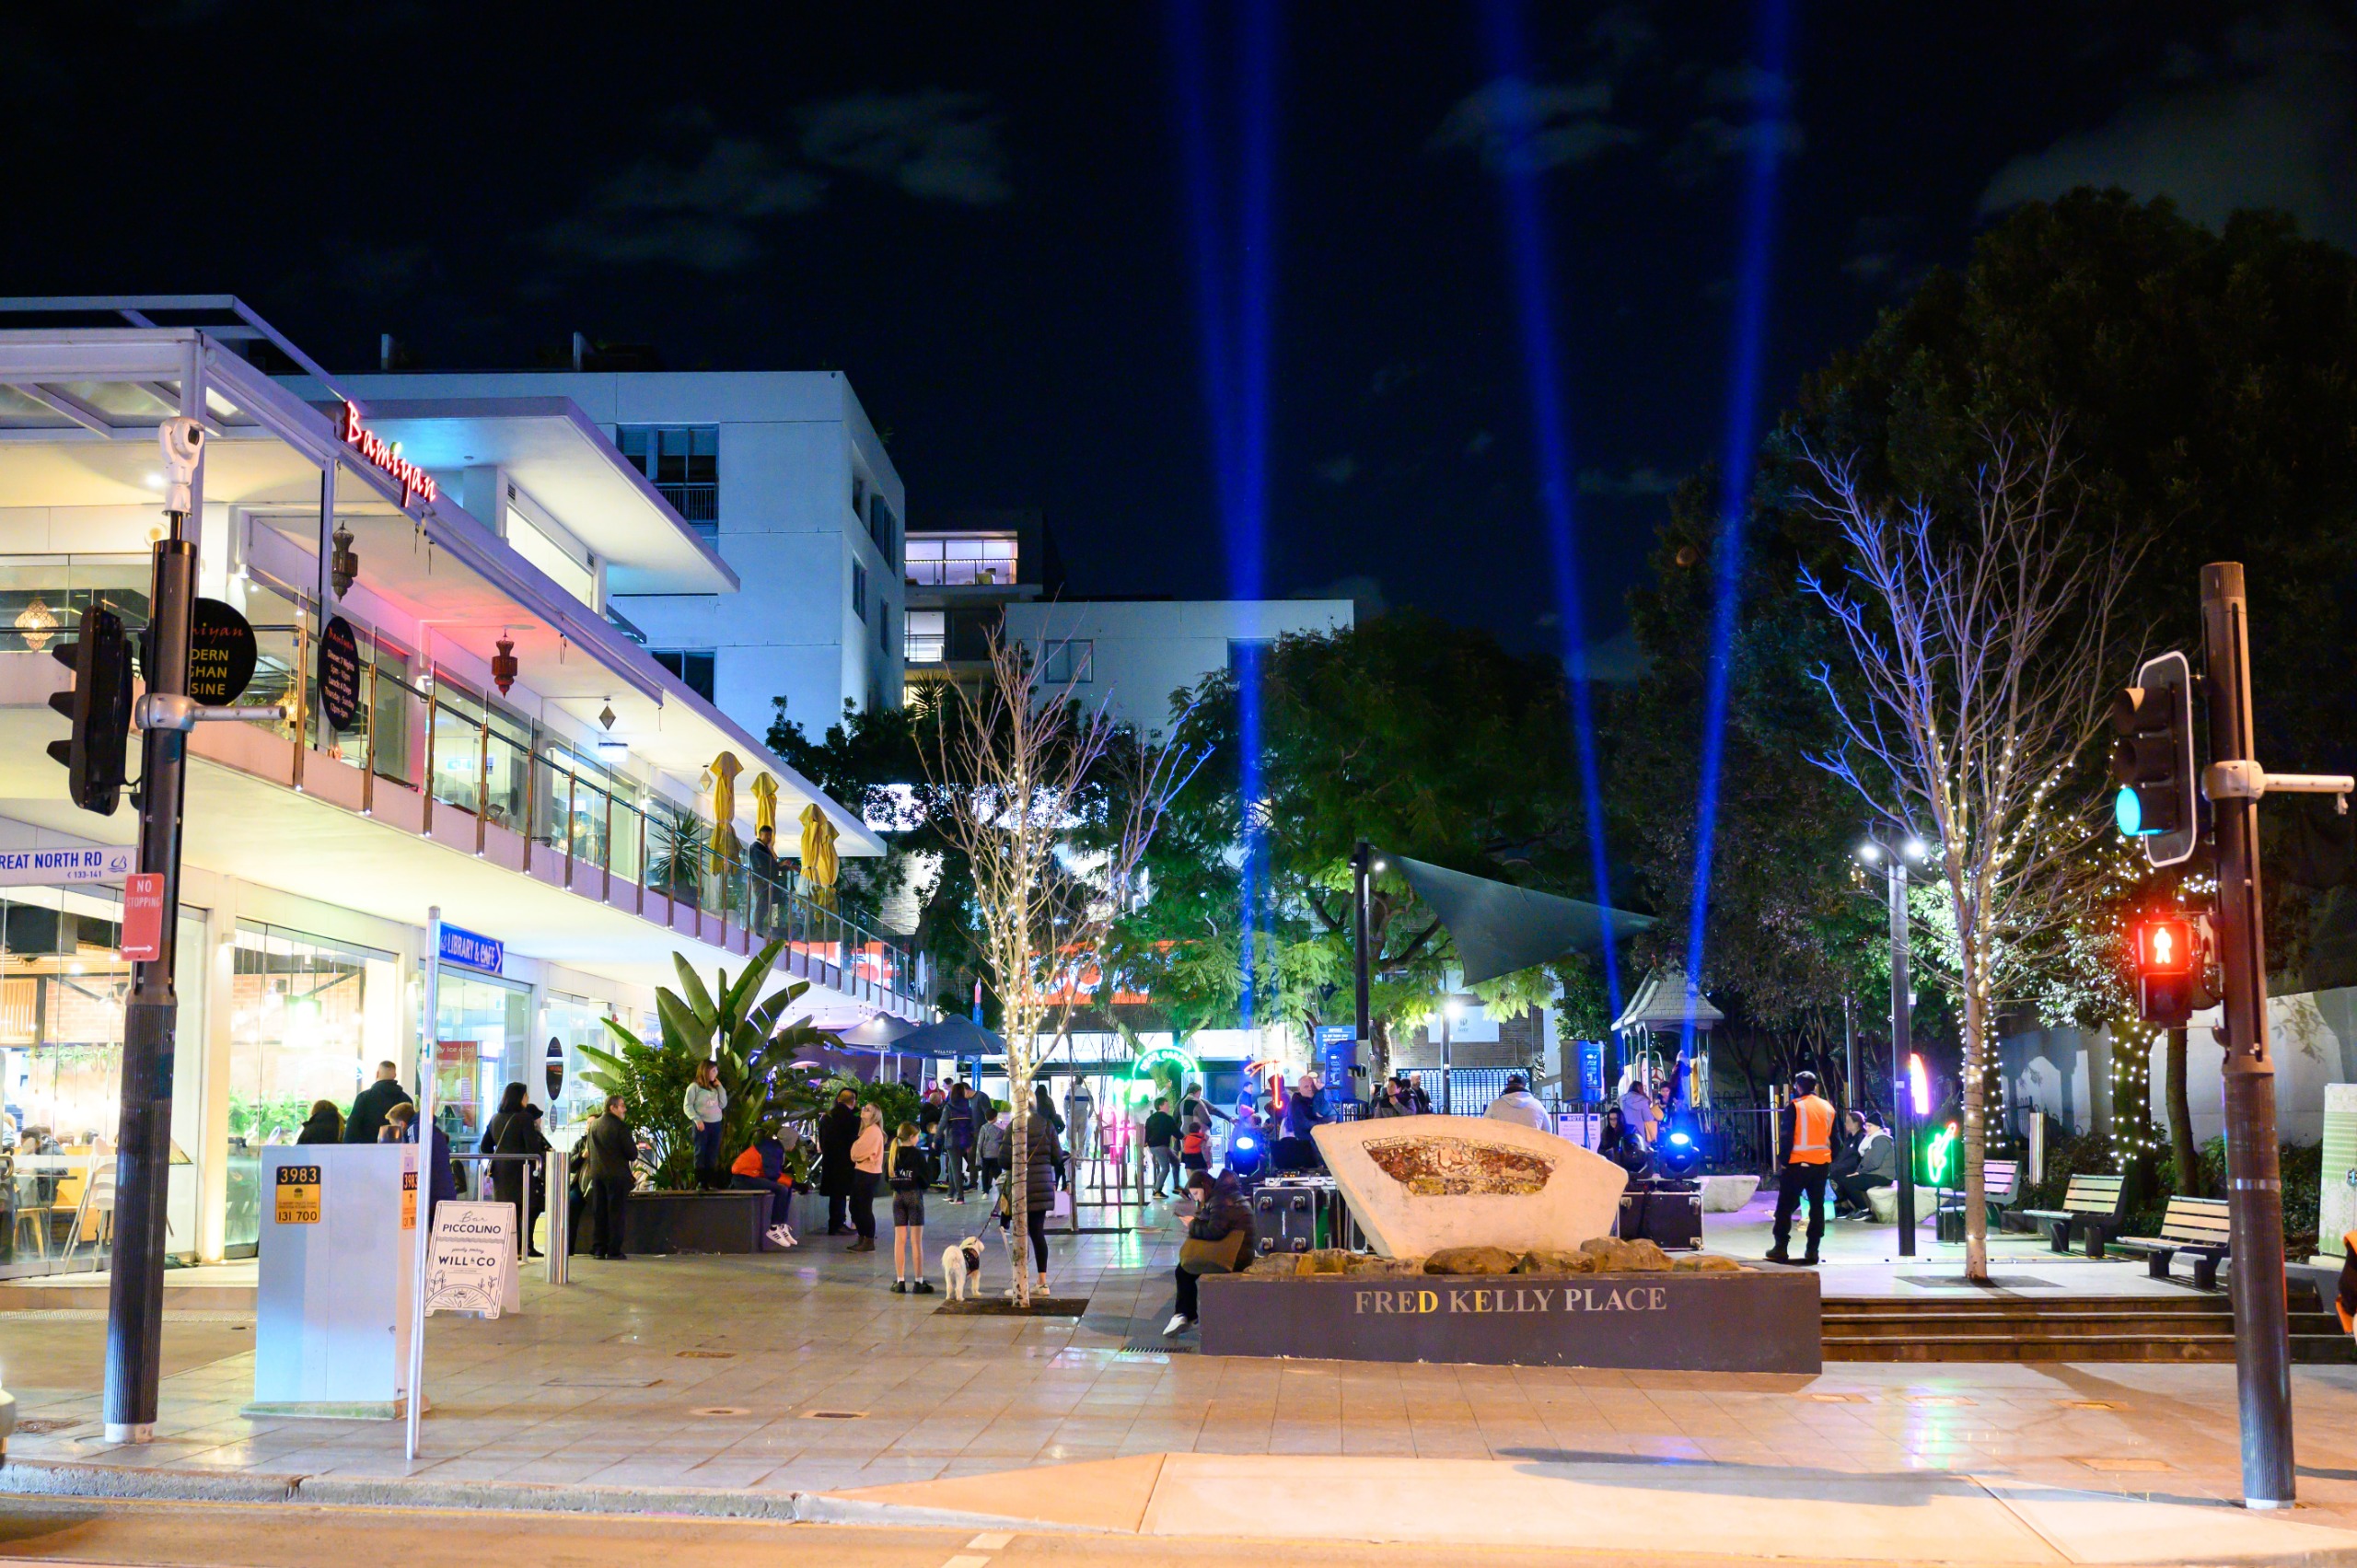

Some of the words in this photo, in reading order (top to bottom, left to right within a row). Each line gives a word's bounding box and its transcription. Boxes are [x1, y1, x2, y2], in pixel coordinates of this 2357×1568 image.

[347, 401, 436, 508] Bamiyan
[191, 648, 229, 661] DERN
[191, 666, 227, 679] HAN
[191, 682, 226, 695] SINE
[0, 854, 29, 869] REAT
[34, 852, 79, 868] NORTH
[84, 851, 102, 865] RD
[74, 870, 102, 878] 133-141
[136, 879, 152, 892] NO
[127, 896, 161, 908] STOPPING
[447, 933, 474, 960] LIBRARY
[474, 941, 479, 962] &
[280, 1167, 318, 1183] 3983
[278, 1211, 292, 1221] 131
[296, 1211, 318, 1221] 700
[459, 1211, 488, 1223] Bar
[442, 1224, 502, 1234] PICCOLINO
[1354, 1290, 1439, 1314] FRED
[1448, 1289, 1555, 1313] KELLY
[1564, 1287, 1667, 1312] PLACE
